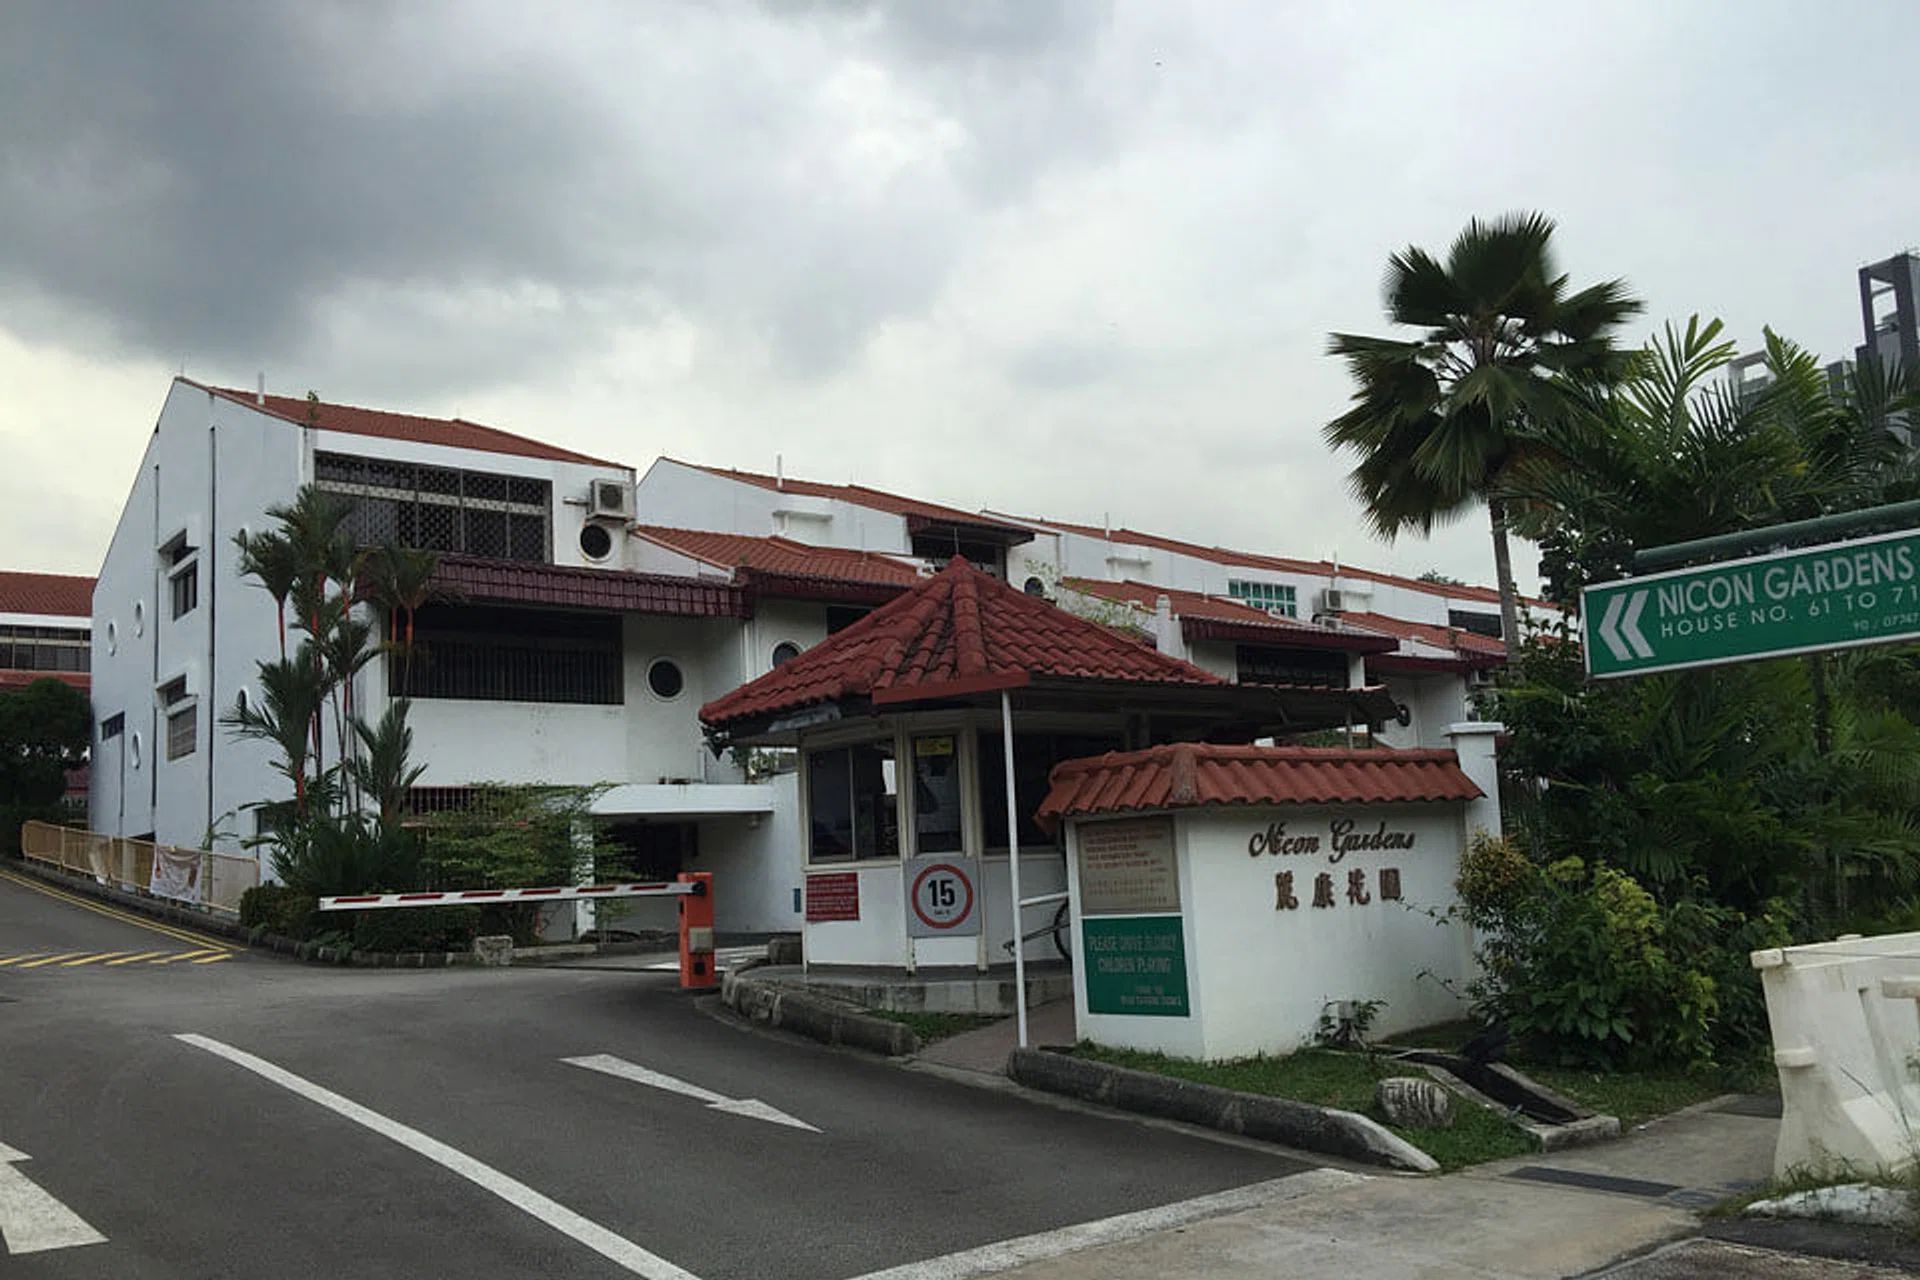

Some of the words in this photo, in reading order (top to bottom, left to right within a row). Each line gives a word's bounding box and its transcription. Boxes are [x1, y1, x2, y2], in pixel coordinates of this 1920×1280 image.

[1658, 572, 1755, 617] NICON
[1764, 546, 1914, 600] GARDENS
[1661, 614, 1737, 638] HOUSE
[1751, 604, 1793, 624] NO.
[1808, 598, 1830, 616] 61
[1843, 591, 1876, 611] TO
[1892, 584, 1918, 604] 71
[1328, 819, 1416, 863] Gardens
[928, 880, 955, 907] 15
